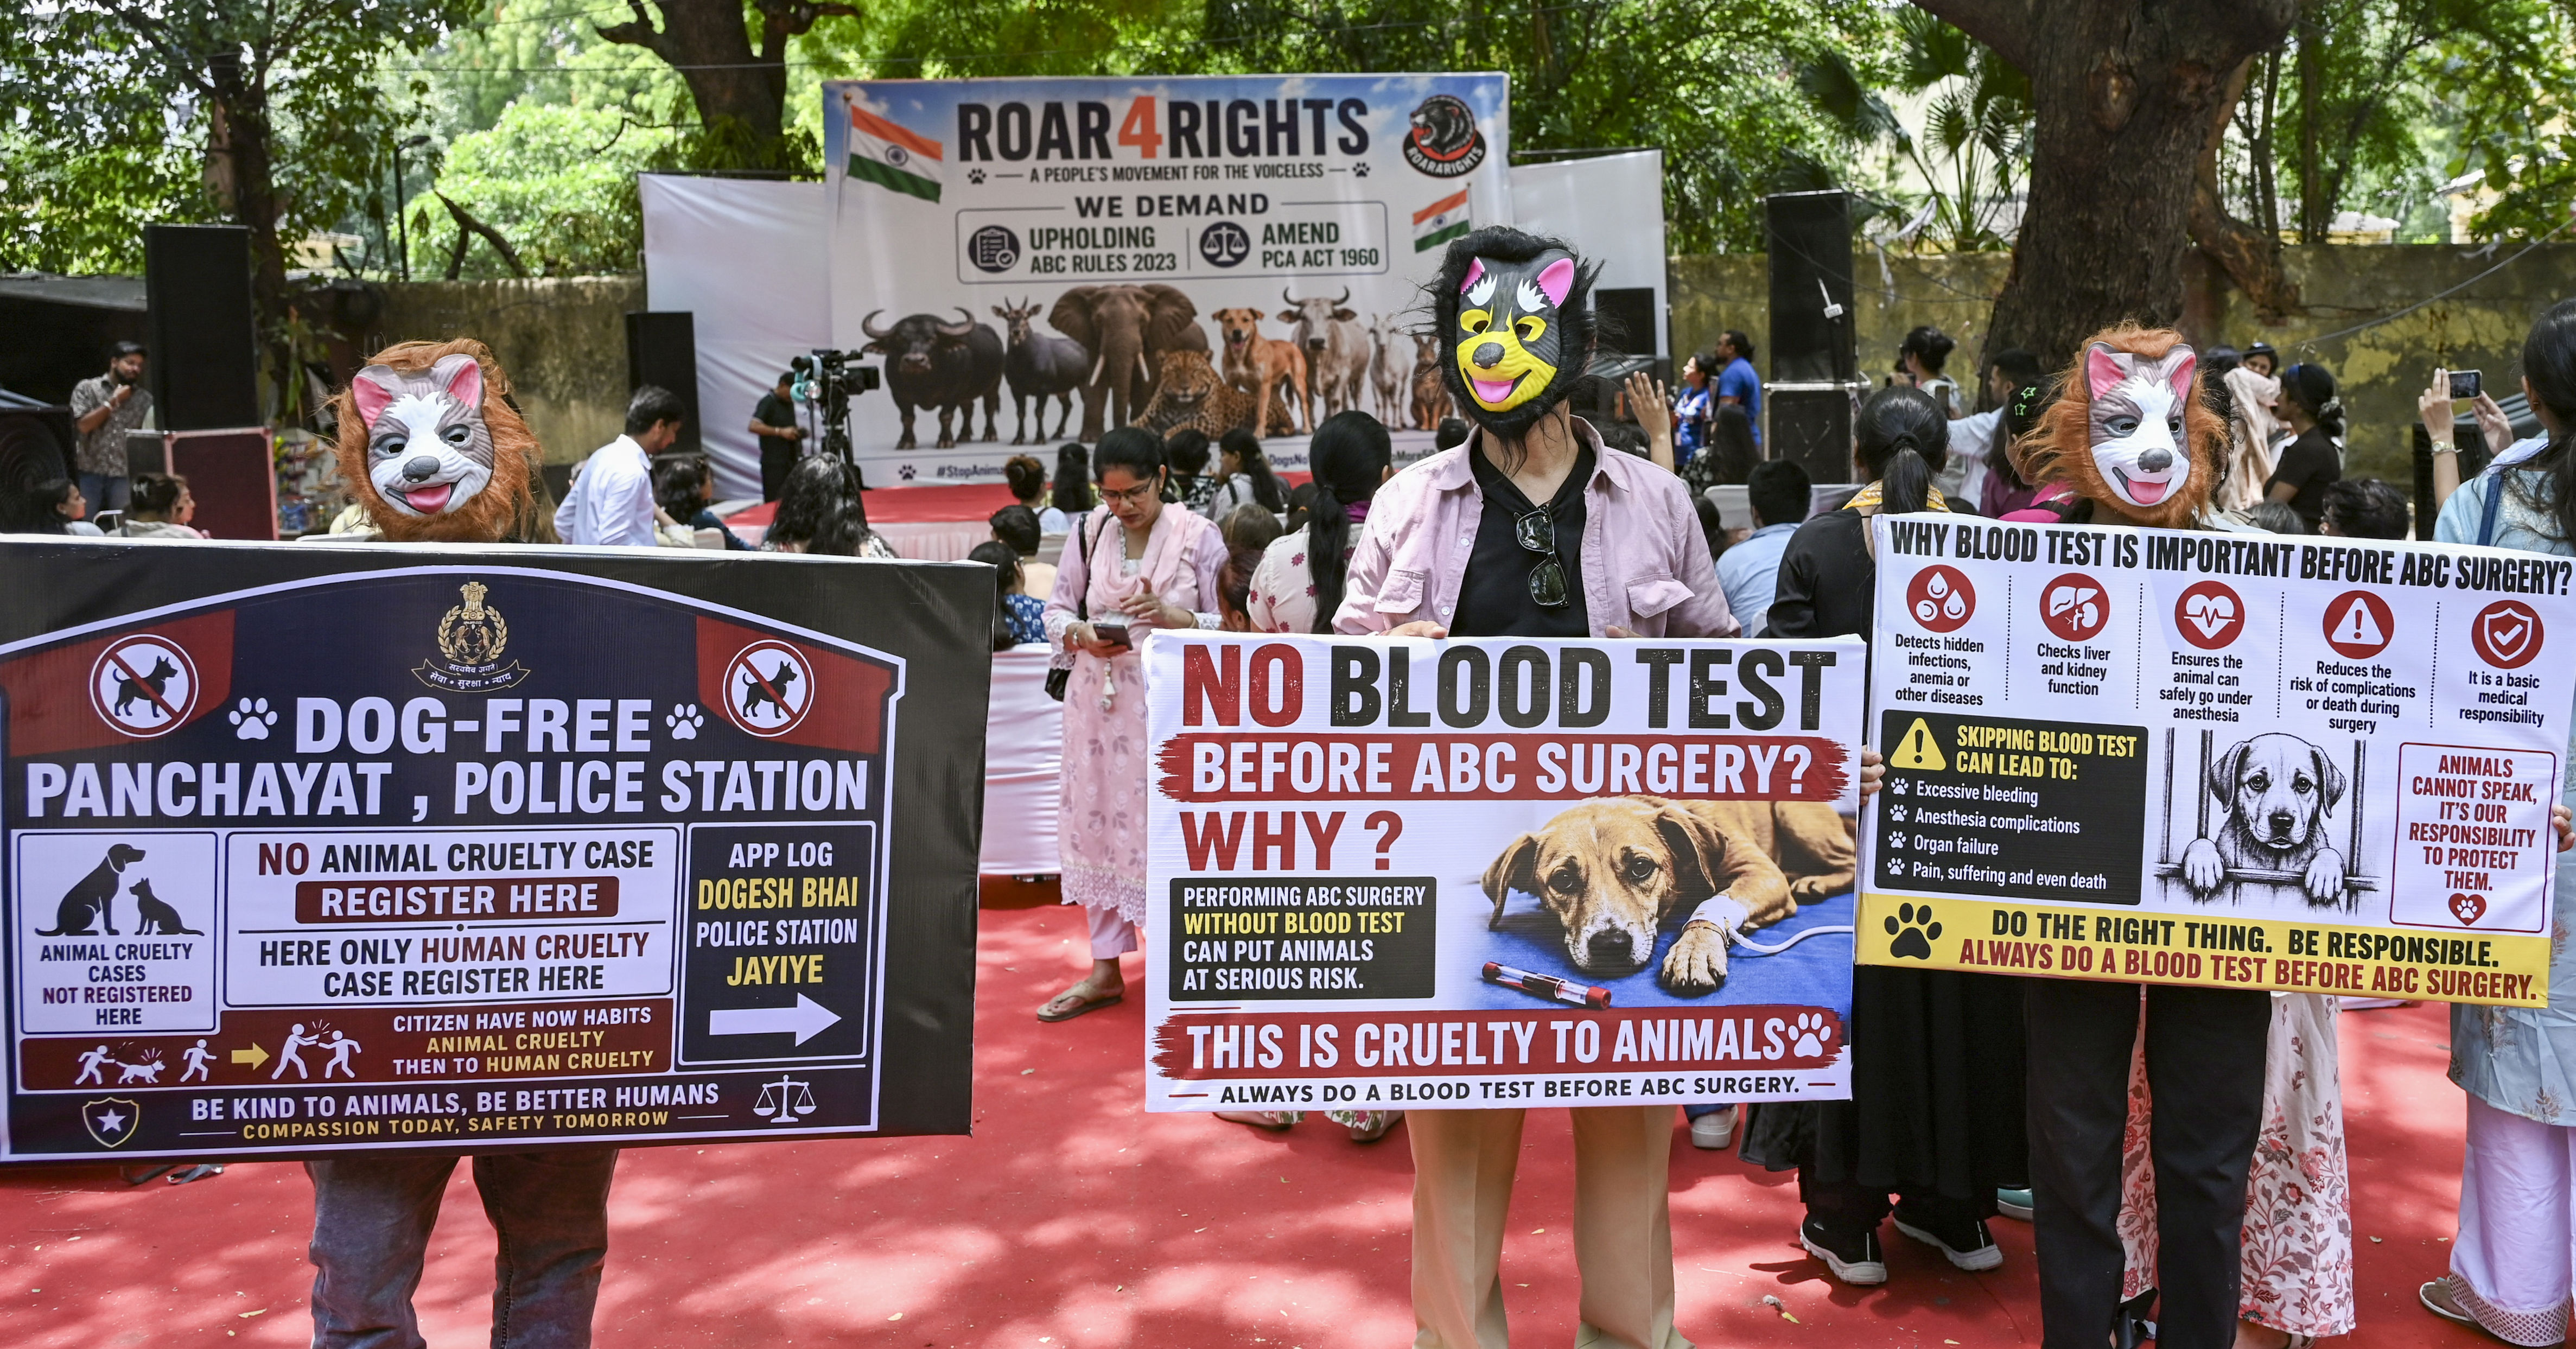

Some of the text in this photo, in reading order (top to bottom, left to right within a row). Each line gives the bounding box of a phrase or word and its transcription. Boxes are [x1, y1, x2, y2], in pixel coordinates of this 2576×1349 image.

[958, 96, 1369, 162] ROAR4RIGHTS
[1031, 163, 1323, 182] A PEOPLE'S MOVEMENT FOR THE VOICELESS
[1076, 194, 1268, 218] WE DEMAND
[1030, 226, 1155, 250] UPHOLDING
[1263, 222, 1339, 245] AMEND
[1031, 253, 1176, 273] ABC RULES 2023
[1263, 249, 1378, 268] PCA ACT 1960
[1891, 521, 2572, 595] WHY BLOOD TEST IS IMPORTANT BEFORE ABC SURGERY?
[1896, 634, 1983, 652] Detects hidden
[2038, 644, 2110, 660] Checks liver
[1909, 651, 1971, 672] infections,
[2041, 662, 2107, 681] and kidney
[430, 671, 448, 684] सेवा
[457, 679, 481, 689] सुरक्षा
[1184, 644, 1836, 731] NO BLOOD TEST
[1910, 672, 1969, 686] anemia or
[2049, 679, 2098, 695] function
[2469, 671, 2539, 688] It is a basic
[1896, 687, 1982, 705] other diseases
[2479, 690, 2527, 705] medical
[296, 697, 651, 754] DOG-FREE
[2459, 708, 2545, 728] responsibility
[1957, 725, 2136, 757] SKIPPING BLOOD TEST
[1193, 742, 1811, 793] BEFORE ABC SURGERY?
[1956, 751, 2077, 780] CAN LEAD TO:
[28, 762, 392, 817] PANCHAYAT
[455, 760, 644, 814] POLICE
[661, 760, 867, 812] STATION
[1917, 780, 2038, 807] Excessive bleeding
[1915, 807, 2079, 833] Anesthesia complications
[1180, 812, 1346, 870] WHY
[1914, 835, 1998, 855] Organ failure
[259, 841, 653, 875] NO ANIMAL CRUELTY CASE
[729, 842, 832, 868] APP LOG
[1913, 862, 2106, 889] Pain, suffering and even death
[322, 883, 597, 916] REGISTER HERE
[698, 877, 857, 909] DOGESH BHAI
[1185, 886, 1426, 907] PERFORMING ABC SURGERY
[696, 919, 857, 947] POLICE STATION
[1184, 912, 1404, 934] WITHOUT BLOOD TEST
[261, 932, 649, 966] HERE ONLY HUMAN CRUELTY
[1184, 939, 1373, 962] CAN PUT ANIMALS
[1993, 910, 2498, 968] DO THE RIGHT THING. BE RESPONSIBLE.
[325, 965, 603, 997] CASE REGISTER HERE
[727, 955, 823, 985] JAYIYE
[1183, 968, 1363, 990] AT SERIOUS RISK.
[1960, 939, 2536, 1000] ALWAYS DO A BLOOD TEST BEFORE ABC SURGERY.
[1187, 1018, 1785, 1068] THIS IS CRUELTY TO ANIMALS
[193, 1083, 718, 1120] BE KIND TO ANIMALS, BE BETTER HUMANS
[1220, 1077, 1799, 1103] ALWAYS DO A BLOOD TEST BEFORE ABC SURGERY.
[244, 1111, 668, 1139] COMPASSION TODAY, SAFETY TOMORROW
